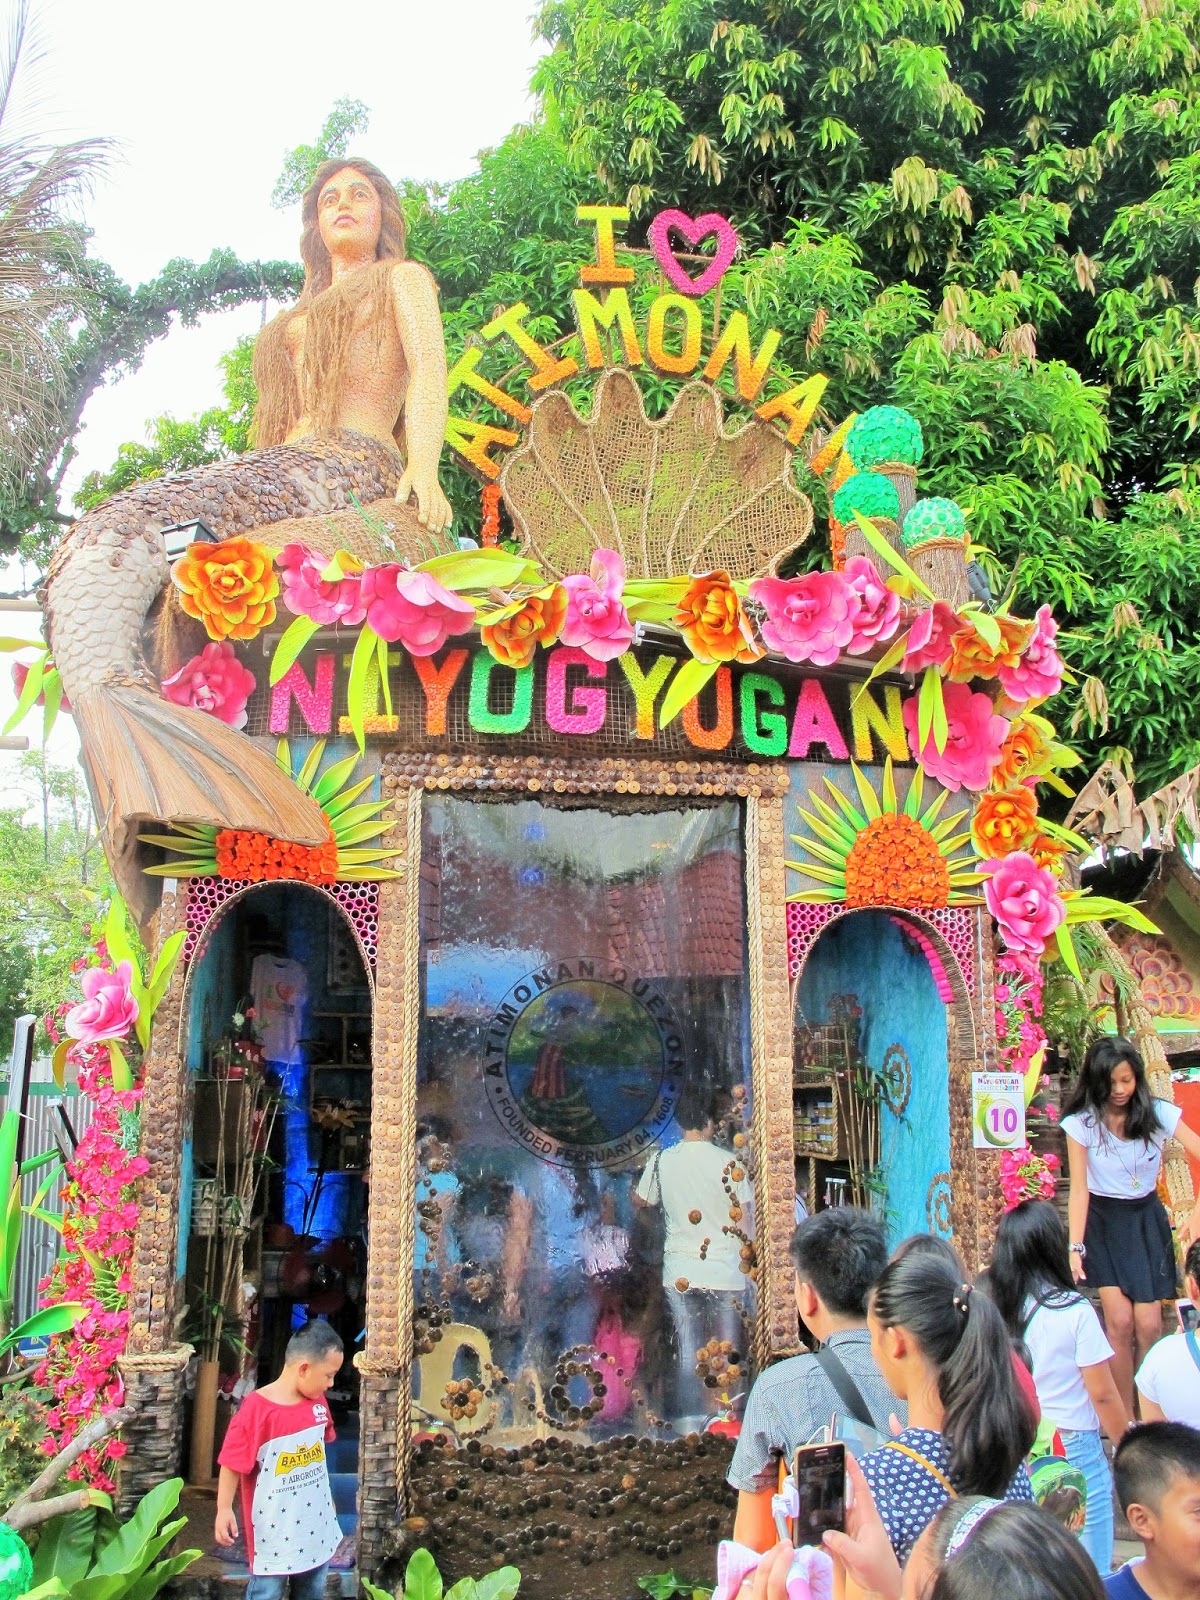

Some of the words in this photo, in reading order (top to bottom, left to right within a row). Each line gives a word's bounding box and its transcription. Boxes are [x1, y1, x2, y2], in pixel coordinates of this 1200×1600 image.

[576, 206, 635, 283] I
[269, 647, 910, 762] NIYOGYUGAN
[485, 960, 595, 1078] ATIMONAN
[610, 968, 684, 1077] QUEZON
[498, 1097, 553, 1155] FOUNDED
[555, 1140, 633, 1163] FEBRUARY
[652, 1096, 674, 1126] 1608
[991, 1108, 1018, 1133] 10
[281, 1444, 322, 1467] BATMAN
